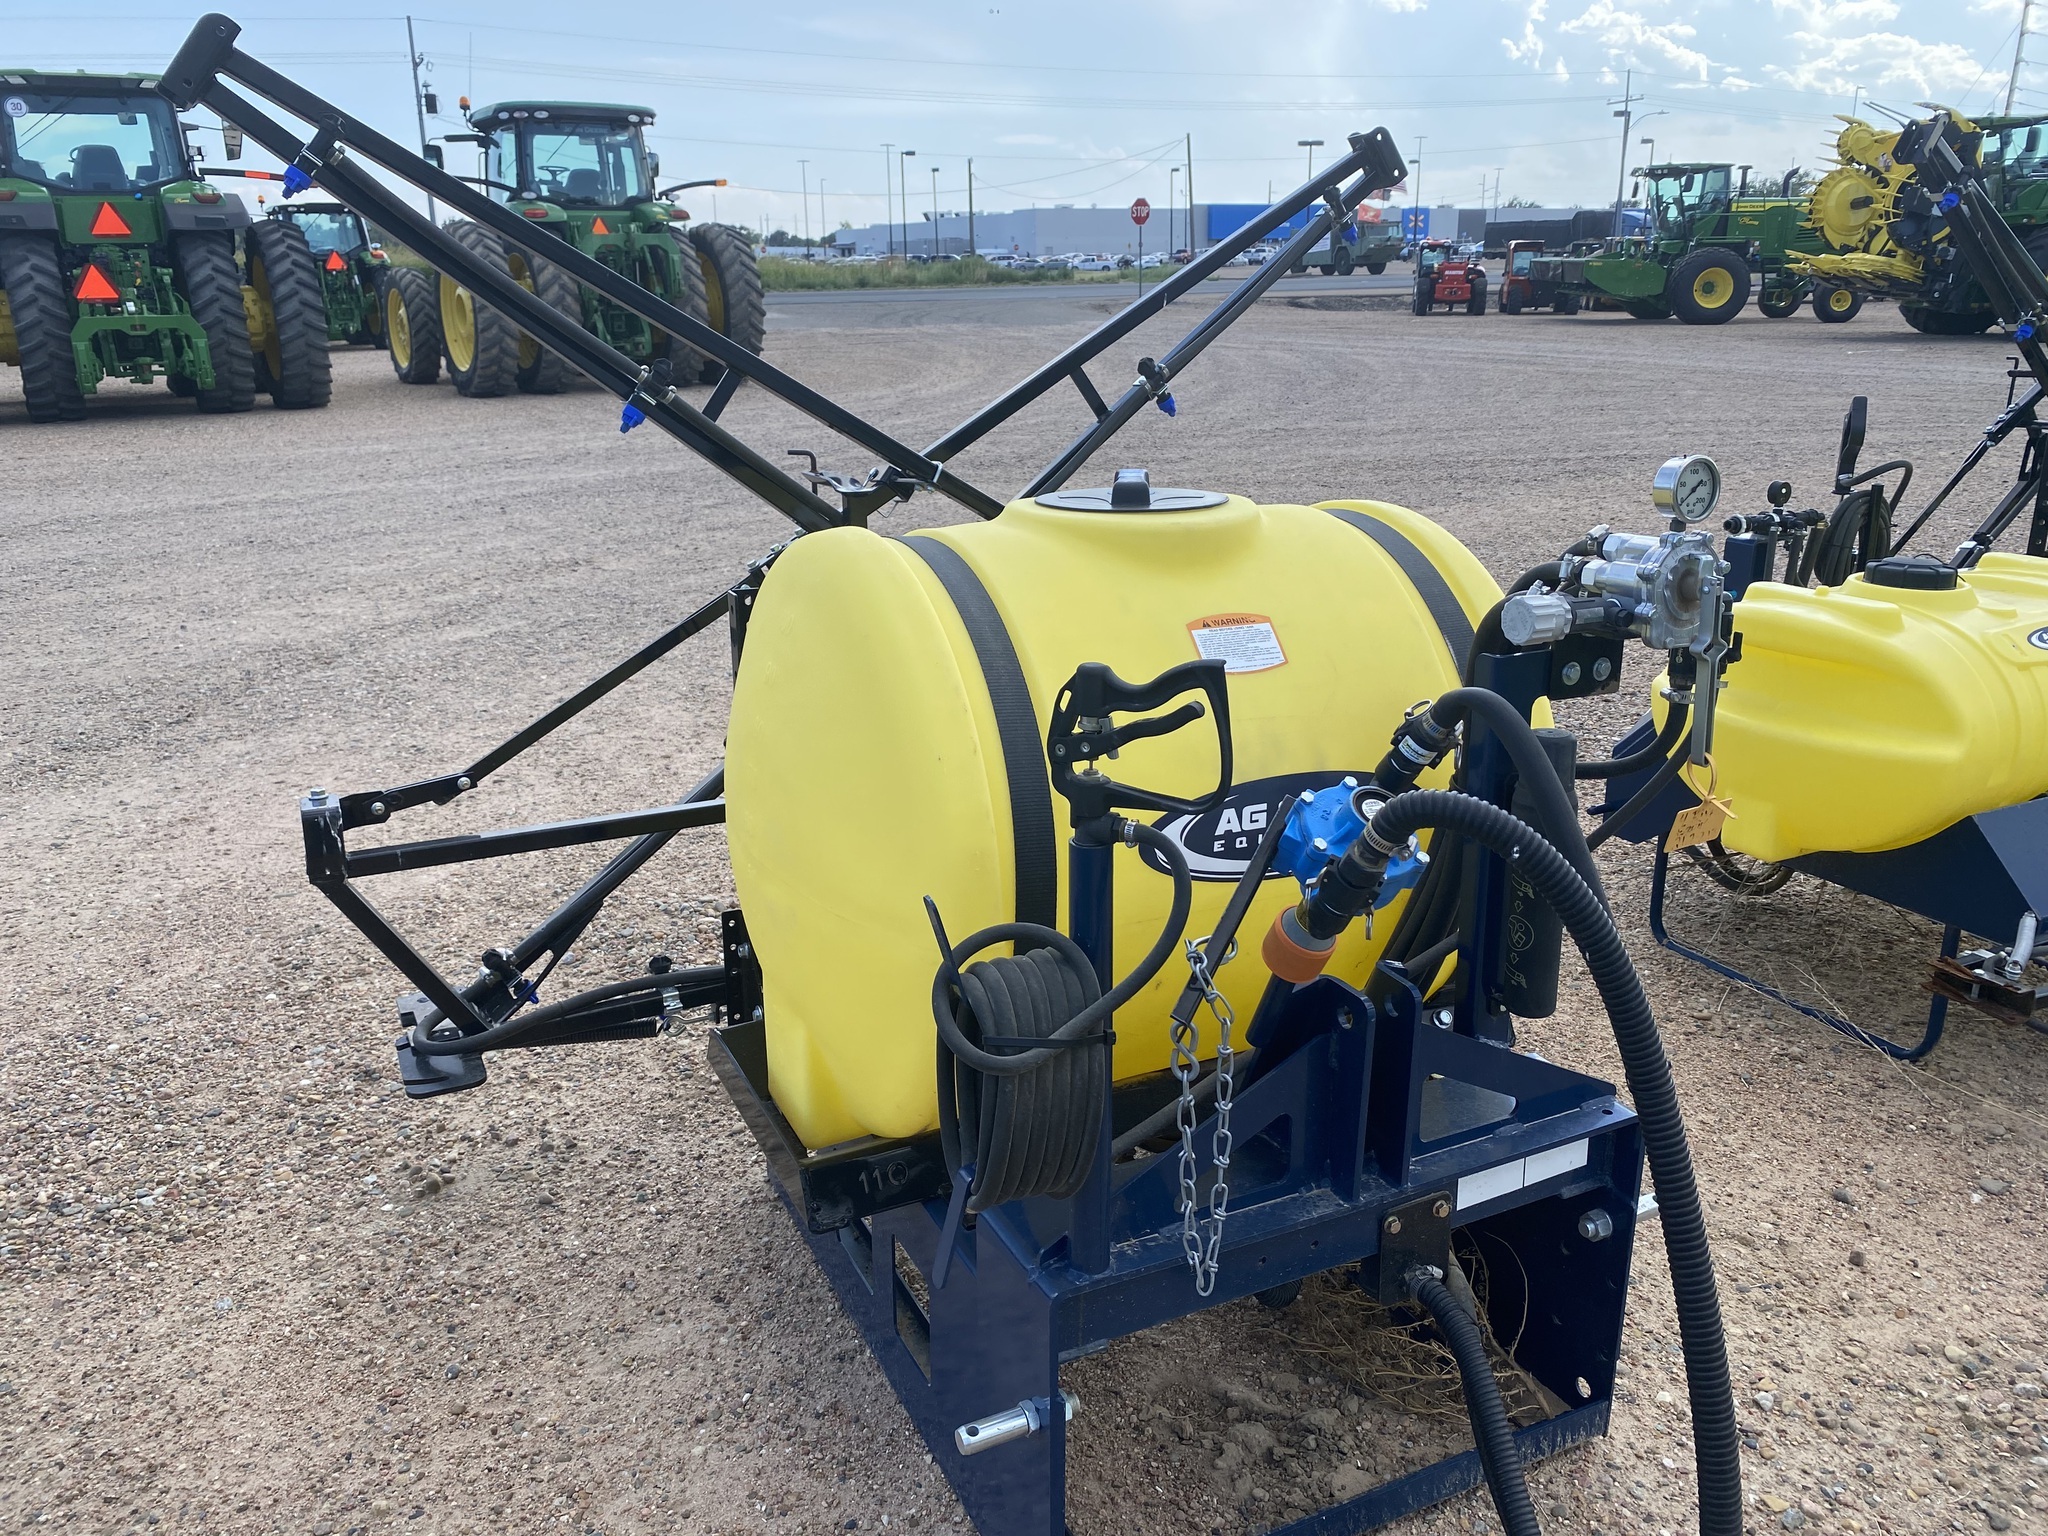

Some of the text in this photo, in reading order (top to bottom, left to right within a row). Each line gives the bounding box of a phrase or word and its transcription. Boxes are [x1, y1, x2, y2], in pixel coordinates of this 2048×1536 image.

[10, 102, 22, 111] 30
[1132, 206, 1149, 217] STOP
[1214, 802, 1268, 836] AG
[858, 1160, 909, 1195] 110
